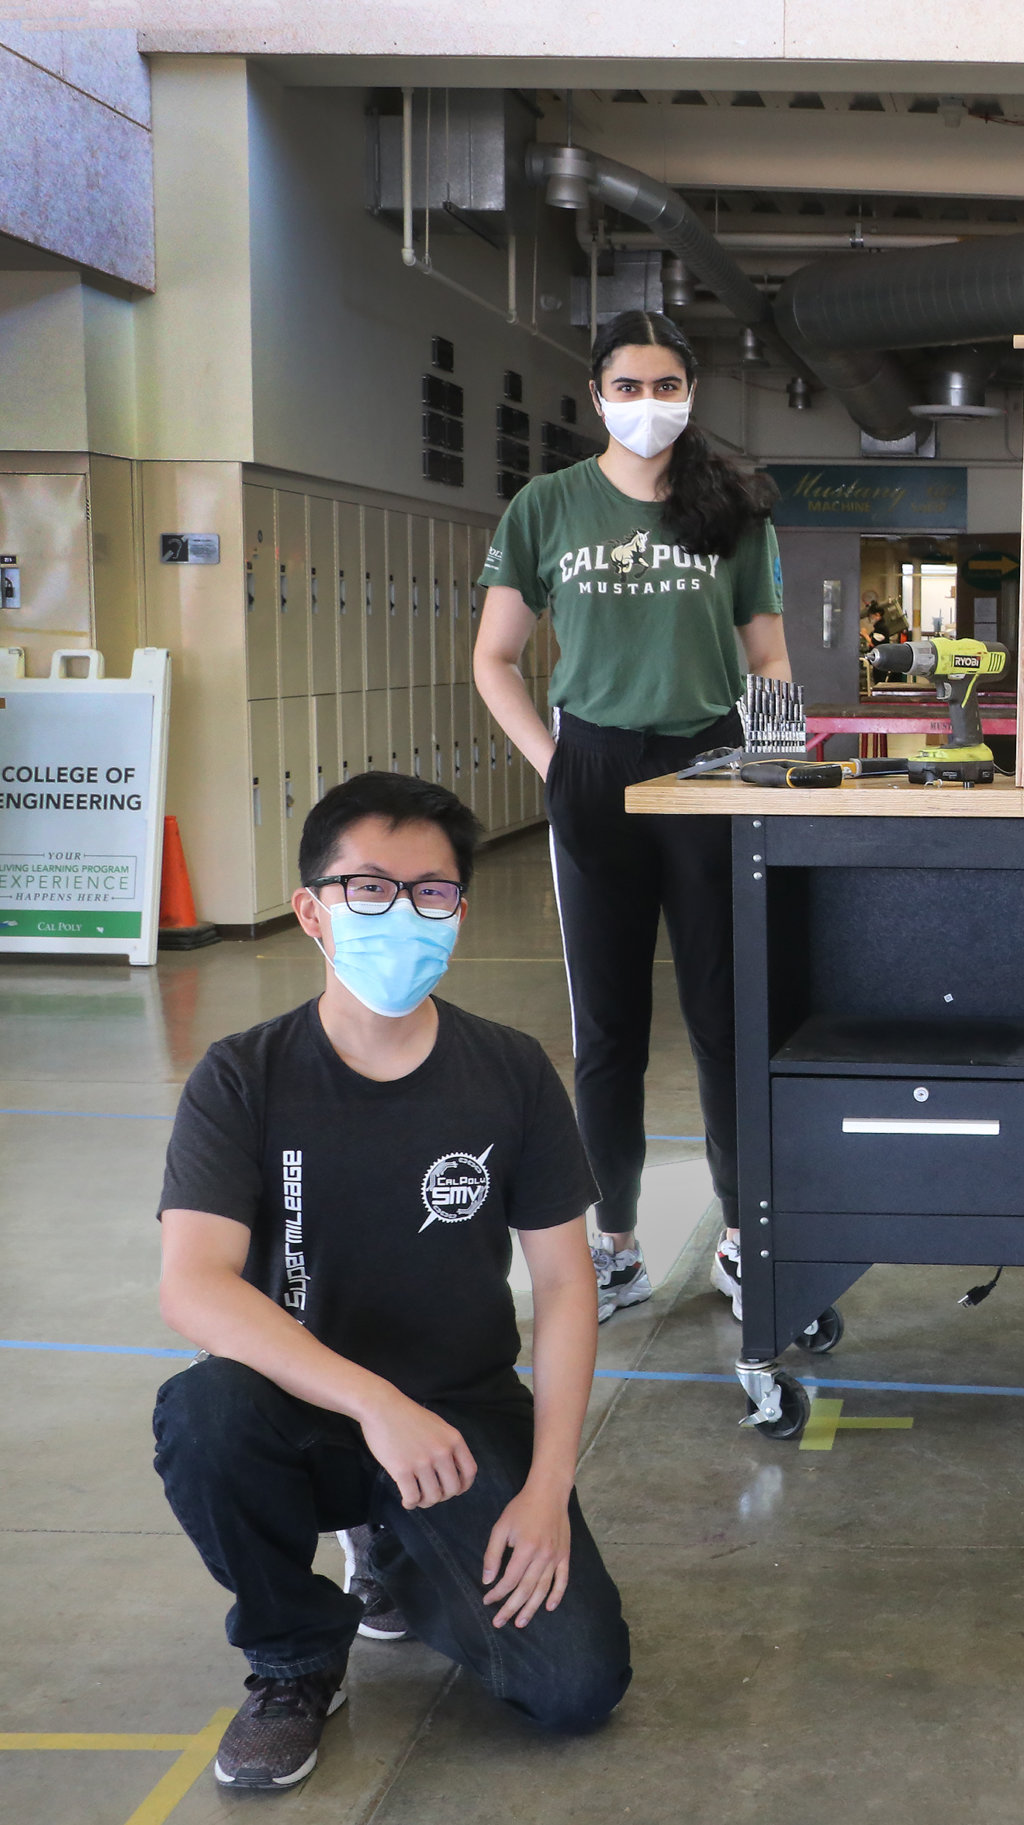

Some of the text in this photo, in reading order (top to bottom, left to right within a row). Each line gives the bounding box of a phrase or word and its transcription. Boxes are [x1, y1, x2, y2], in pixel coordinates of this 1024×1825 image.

[793, 470, 907, 513] Mustang
[808, 500, 871, 513] MACHINE
[559, 545, 609, 583] CAL
[579, 578, 701, 595] MUSTANGS
[954, 656, 979, 667] RYOBI
[2, 766, 136, 784] COLLEGE OF
[48, 852, 82, 861] YOUR
[32, 864, 79, 873] LEARNING
[82, 865, 129, 874] PROGRAM
[0, 874, 129, 890] EXPERIENCE
[15, 892, 109, 902] HAPPENS HERE
[37, 921, 83, 932] CAL POLY
[432, 1186, 482, 1205] SMV
